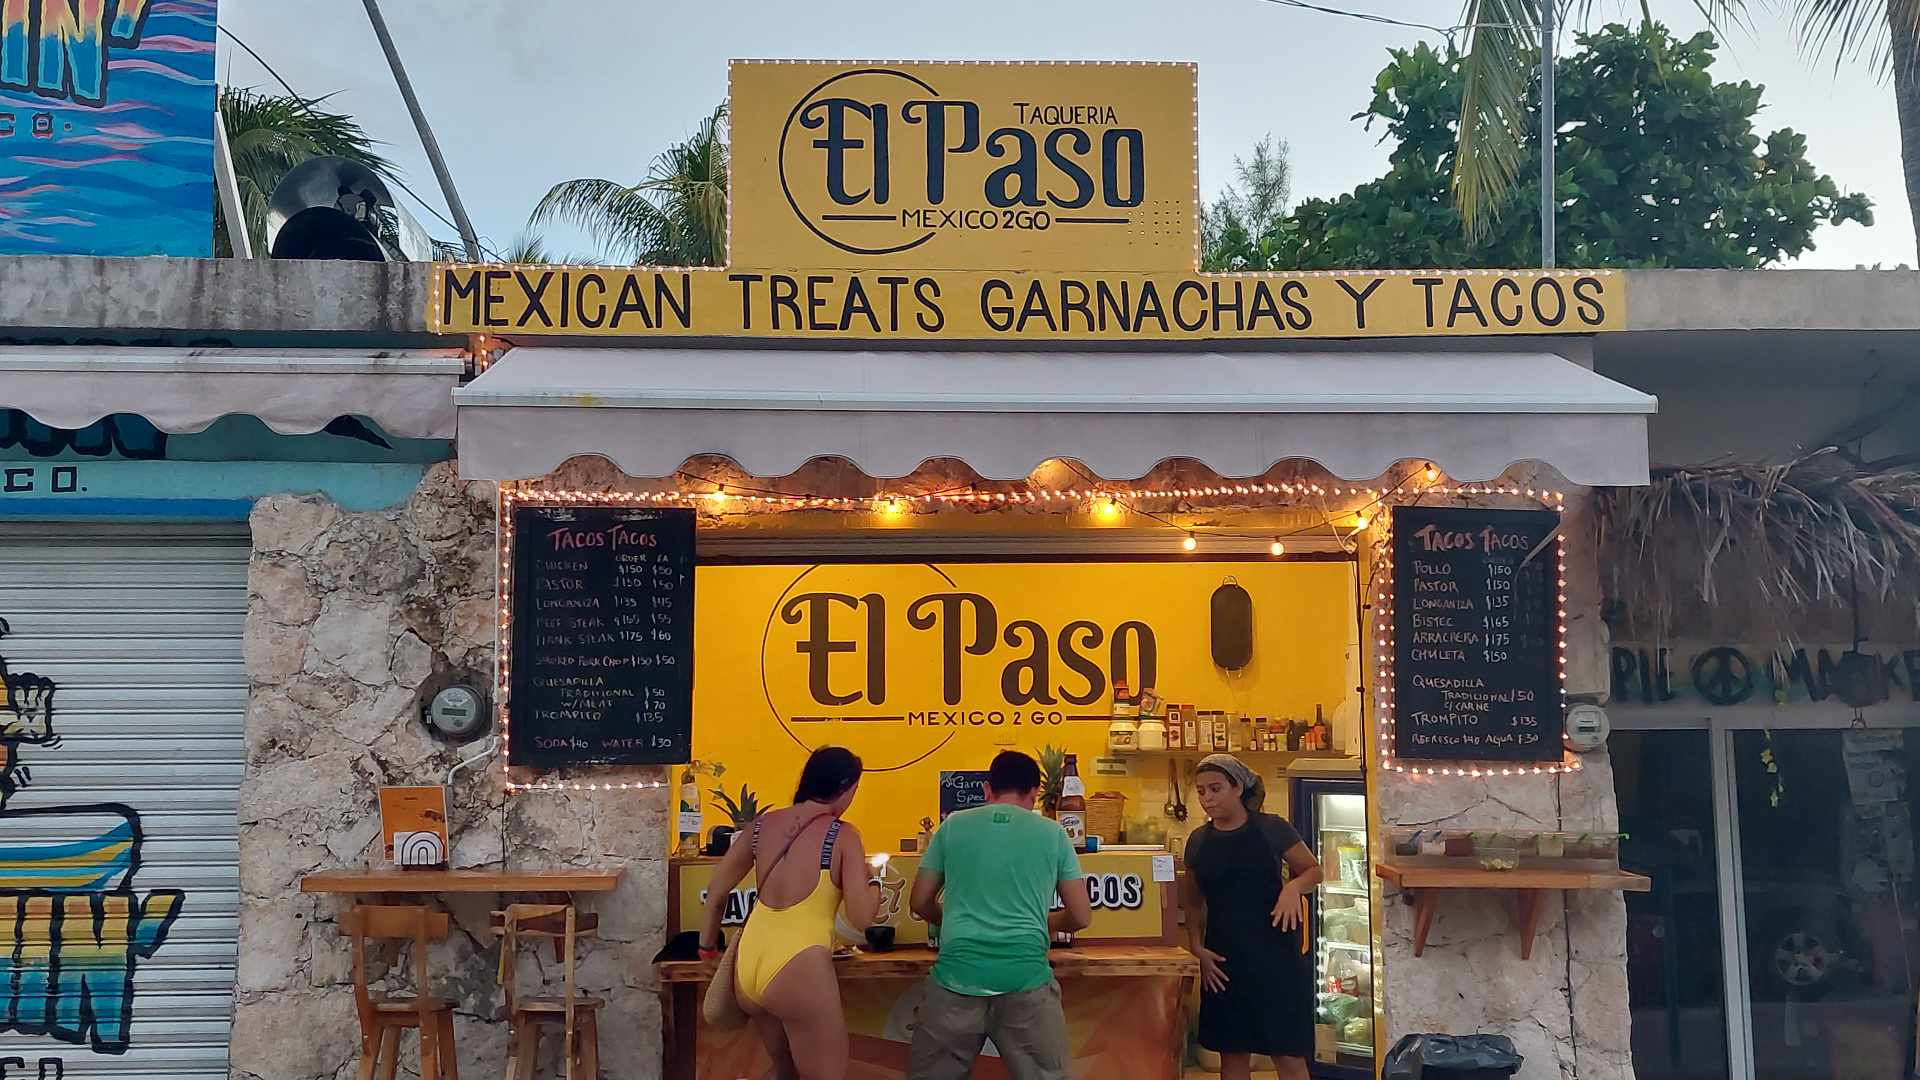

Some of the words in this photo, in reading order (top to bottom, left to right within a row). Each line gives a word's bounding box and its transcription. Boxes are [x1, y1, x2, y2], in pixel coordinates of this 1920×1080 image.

[1012, 102, 1119, 126] TAQUERIA
[799, 97, 890, 206] El
[901, 100, 1146, 209] Paso
[442, 268, 692, 329] MEXICAN
[728, 274, 945, 333] TREATS
[980, 278, 1313, 333] GARNACHAS
[1335, 278, 1385, 329] Y
[1411, 276, 1606, 329] TACOS
[548, 527, 605, 550] TACOS
[607, 524, 657, 551] TACOS
[1413, 524, 1475, 552] TACOS
[1480, 524, 1529, 555] TACOS
[1414, 559, 1452, 575] POLLO
[1413, 578, 1459, 593] PASTOR
[1413, 614, 1454, 628] BISTEC
[780, 592, 887, 706] El
[906, 592, 1158, 706] Paso
[1411, 649, 1466, 662] CHULETA
[1412, 674, 1485, 690] QUESADILLA
[908, 711, 1005, 726] MEXICO
[1013, 711, 1022, 726] 2
[1030, 711, 1063, 726] GO
[1411, 710, 1479, 727] TROMPITO
